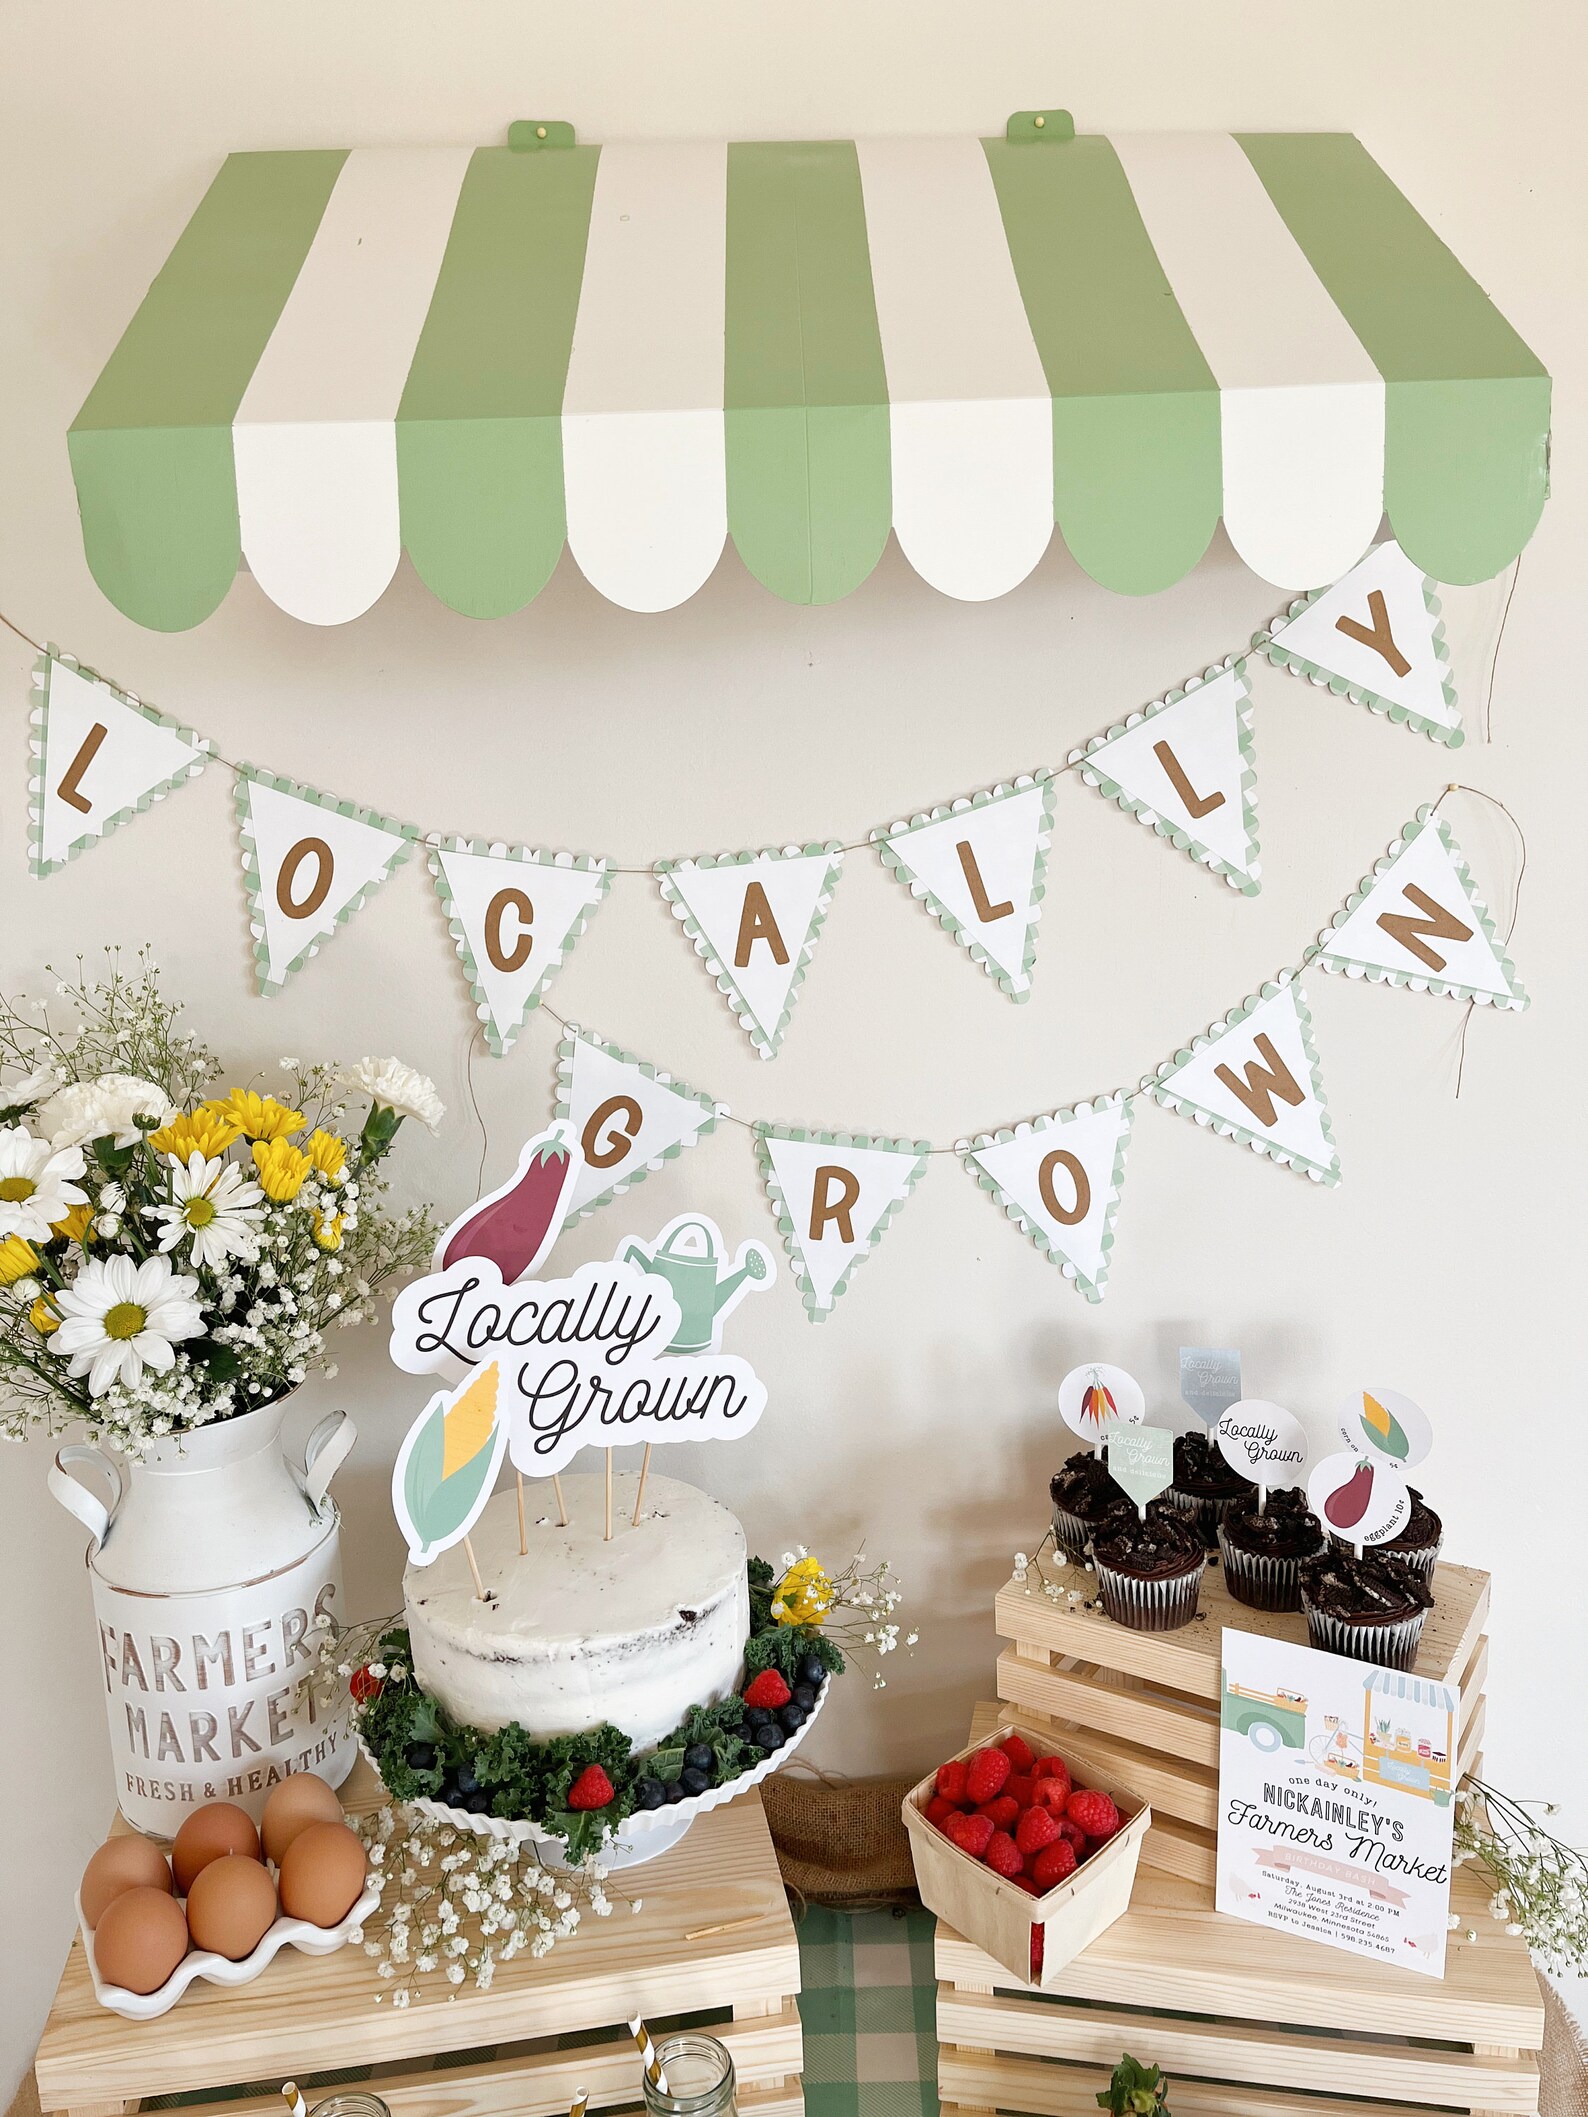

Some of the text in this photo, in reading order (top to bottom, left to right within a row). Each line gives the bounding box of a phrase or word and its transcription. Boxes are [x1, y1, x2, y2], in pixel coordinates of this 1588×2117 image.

[57, 589, 1412, 973] LOCALLY
[581, 883, 1474, 1243] GROWN
[415, 1277, 661, 1367] Locally
[1181, 1356, 1222, 1374] Locally
[1198, 1371, 1239, 1388] Grown
[517, 1359, 747, 1455] Grown
[1109, 1431, 1153, 1452] Locally
[1219, 1418, 1279, 1446] Locally
[1340, 1427, 1359, 1453] corn on
[1126, 1447, 1171, 1466] Grown
[1243, 1440, 1304, 1465] Grown
[1363, 1515, 1400, 1542] eggplant
[98, 1583, 340, 1695] FARMERS
[124, 1677, 319, 1763] MARKET
[125, 1731, 338, 1802] FRESH & HEALTHY
[1288, 1776, 1377, 1809] one day only!
[1263, 1783, 1404, 1842] NICKAINLEY'S
[1228, 1799, 1448, 1884] Farmers Market
[1284, 1852, 1376, 1886] BIRTHDAY BASH
[1268, 1910, 1289, 1922] RSVP
[1285, 1885, 1380, 1922] The Jones Residence
[1306, 1884, 1336, 1898] August
[1338, 1893, 1353, 1903] 3rd
[1356, 1898, 1365, 1906] at
[1387, 1908, 1401, 1917] PM
[1308, 1904, 1328, 1915] West
[1330, 1911, 1348, 1921] 23rd
[1350, 1916, 1375, 1929] Street
[1321, 1916, 1365, 1935] Minnesota
